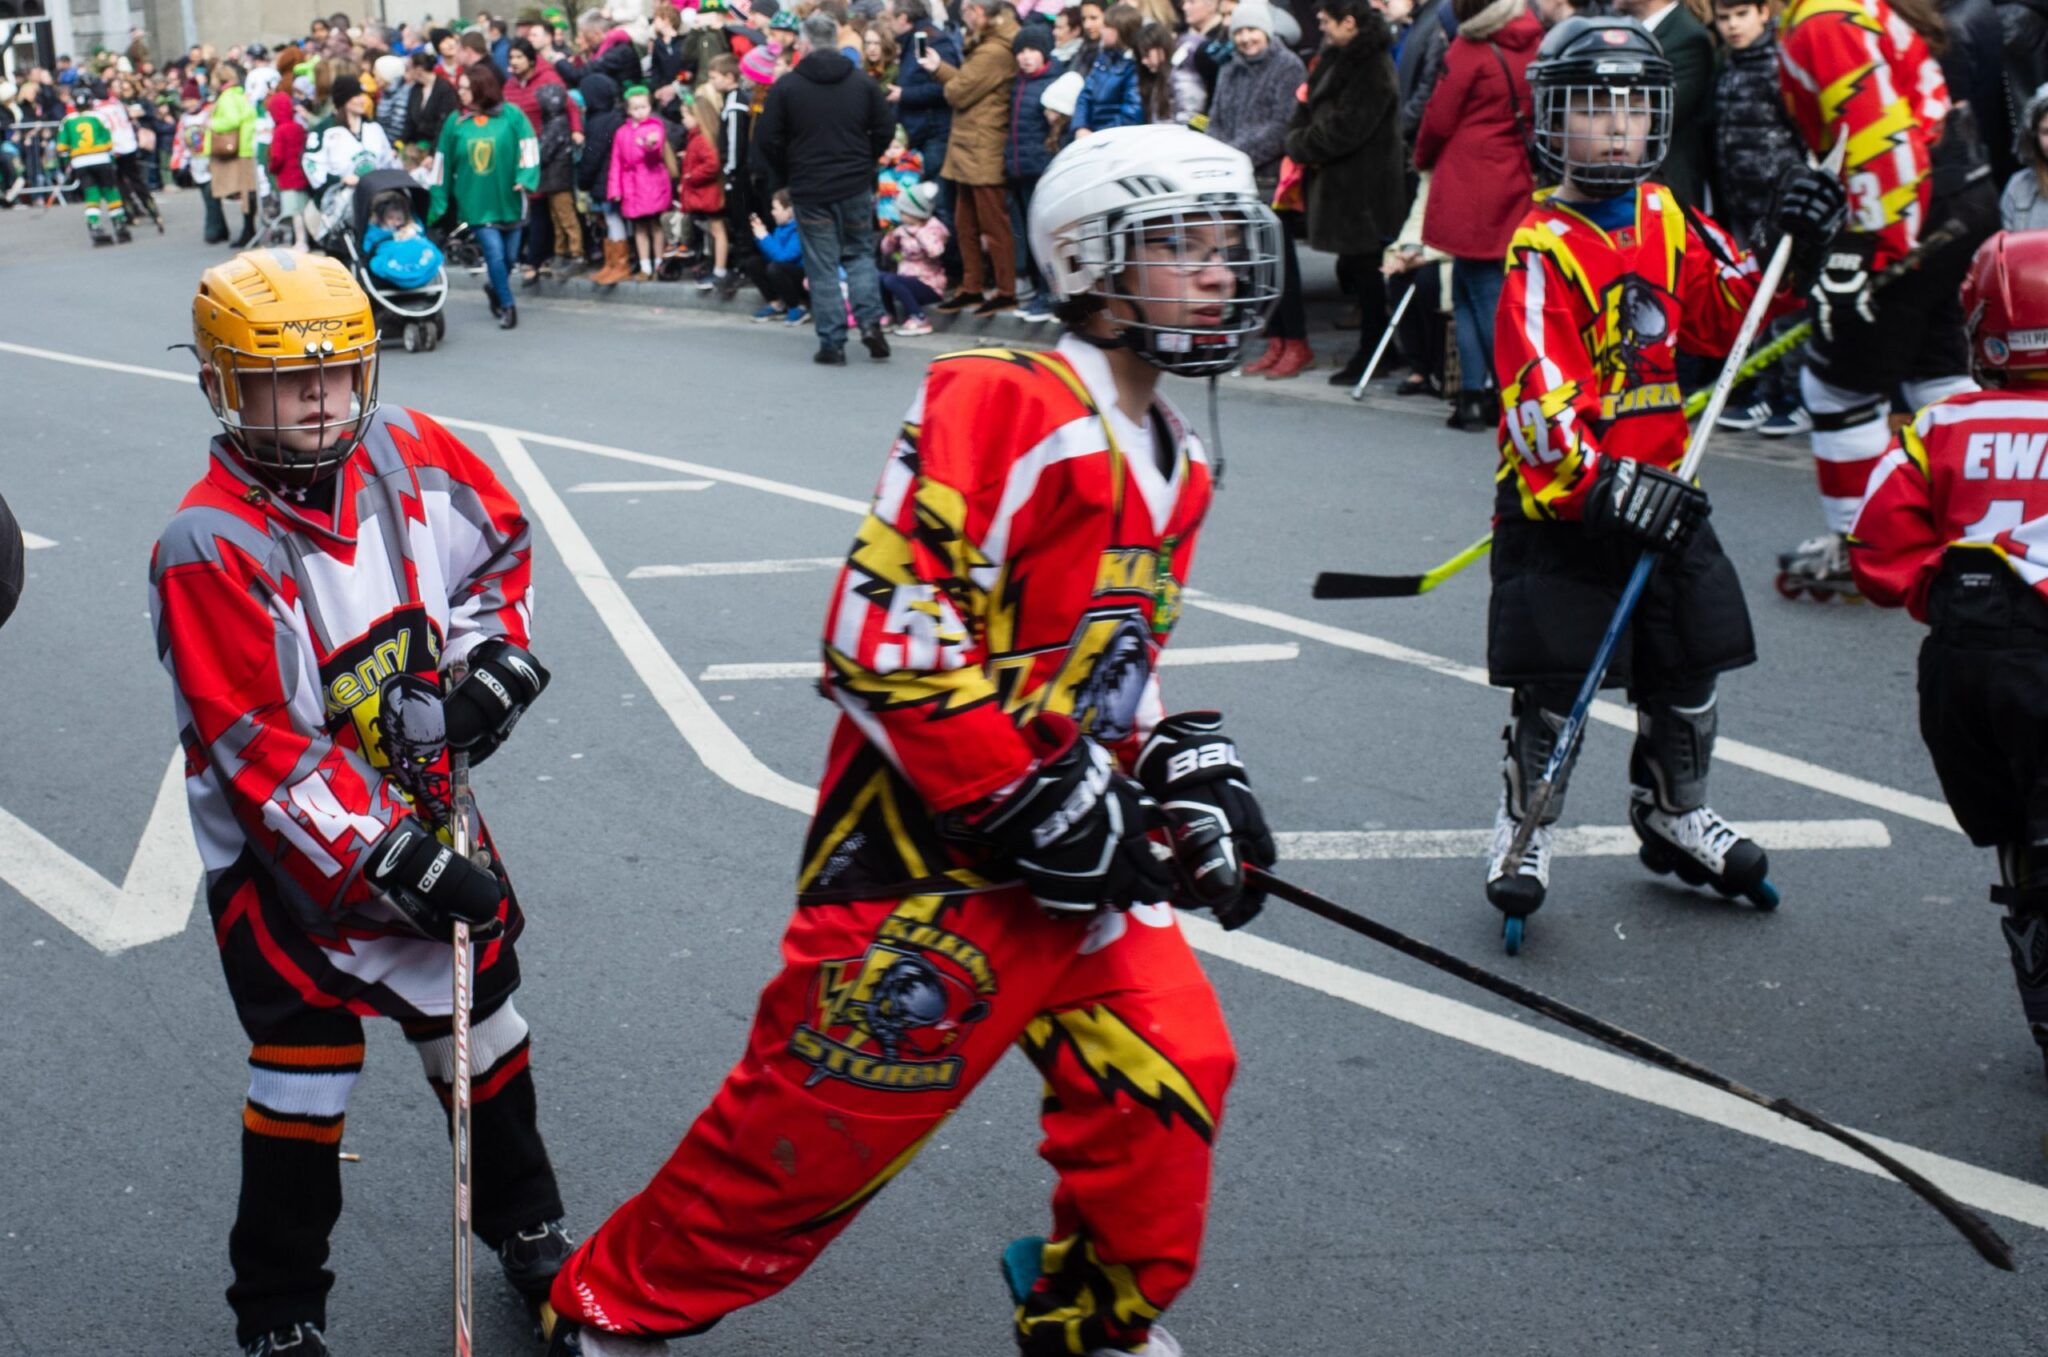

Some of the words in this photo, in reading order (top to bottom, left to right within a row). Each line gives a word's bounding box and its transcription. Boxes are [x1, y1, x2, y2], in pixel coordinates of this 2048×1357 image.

[75, 122, 94, 148] 3
[1506, 400, 1563, 466] 12
[474, 667, 513, 710] CCM
[261, 769, 387, 879] 14
[417, 848, 452, 893] CCM
[456, 946, 469, 1106] FRONTIER
[794, 1028, 959, 1088] STORM
